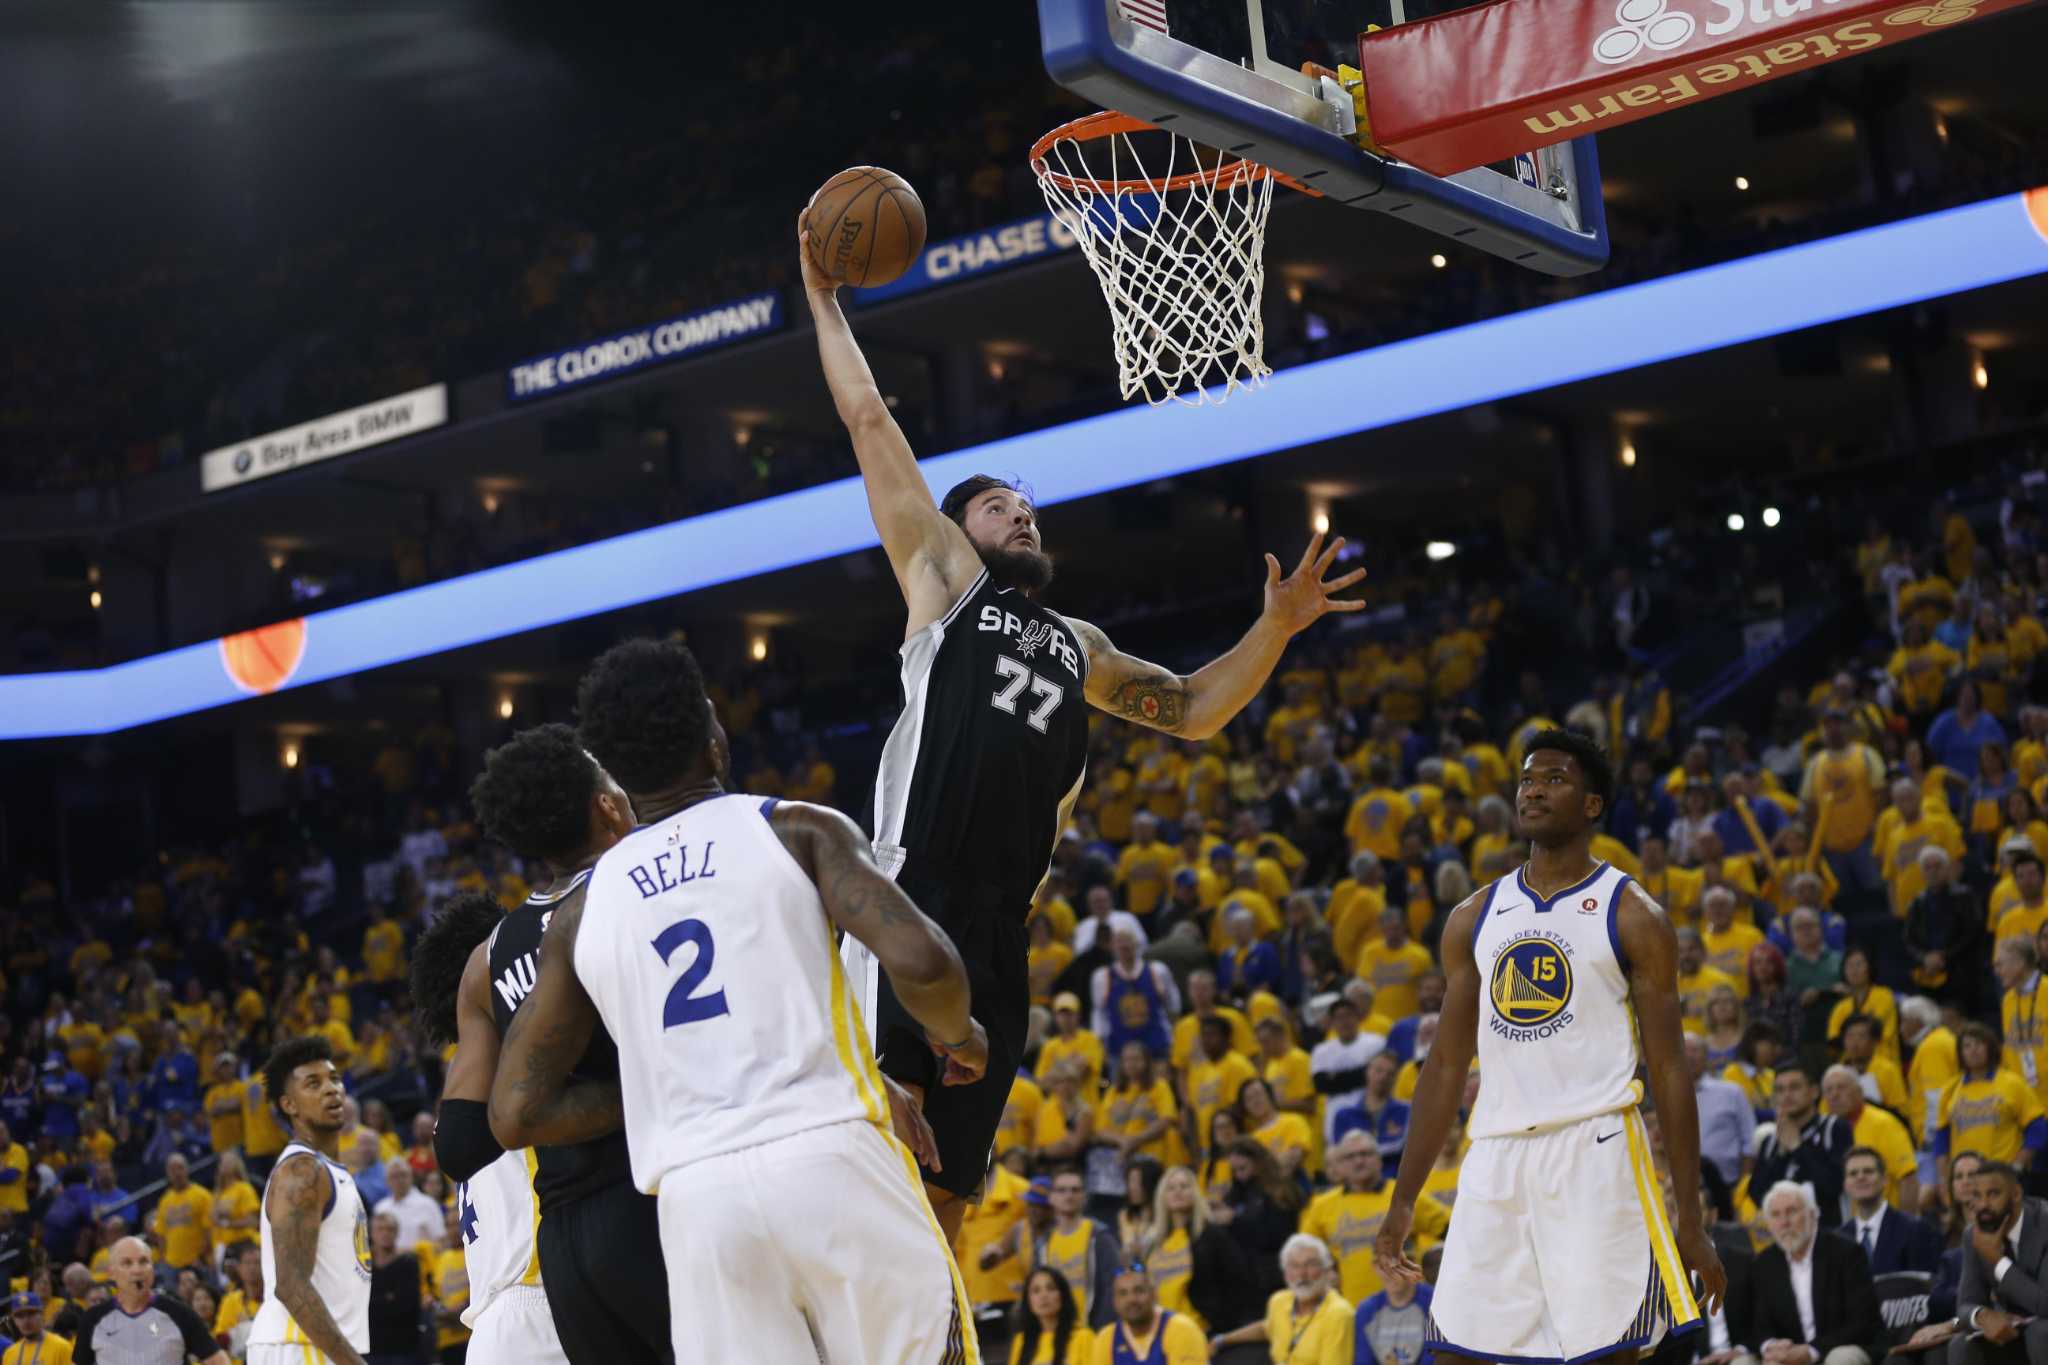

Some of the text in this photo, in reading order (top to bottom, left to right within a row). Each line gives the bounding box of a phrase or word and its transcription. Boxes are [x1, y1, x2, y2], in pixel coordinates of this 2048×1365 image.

[925, 219, 1047, 280] CHASE
[511, 295, 775, 396] THE CLOROX COMPANY
[261, 402, 415, 467] Bay Area BMW
[978, 605, 1079, 680] SPURS
[991, 653, 1065, 735] 77
[627, 841, 717, 899] BELL
[1492, 928, 1575, 958] GOLDEN STATE
[1531, 956, 1558, 982] 15
[494, 948, 540, 1012] MU
[650, 918, 731, 1033] 2
[1489, 1011, 1574, 1043] WARRIORS
